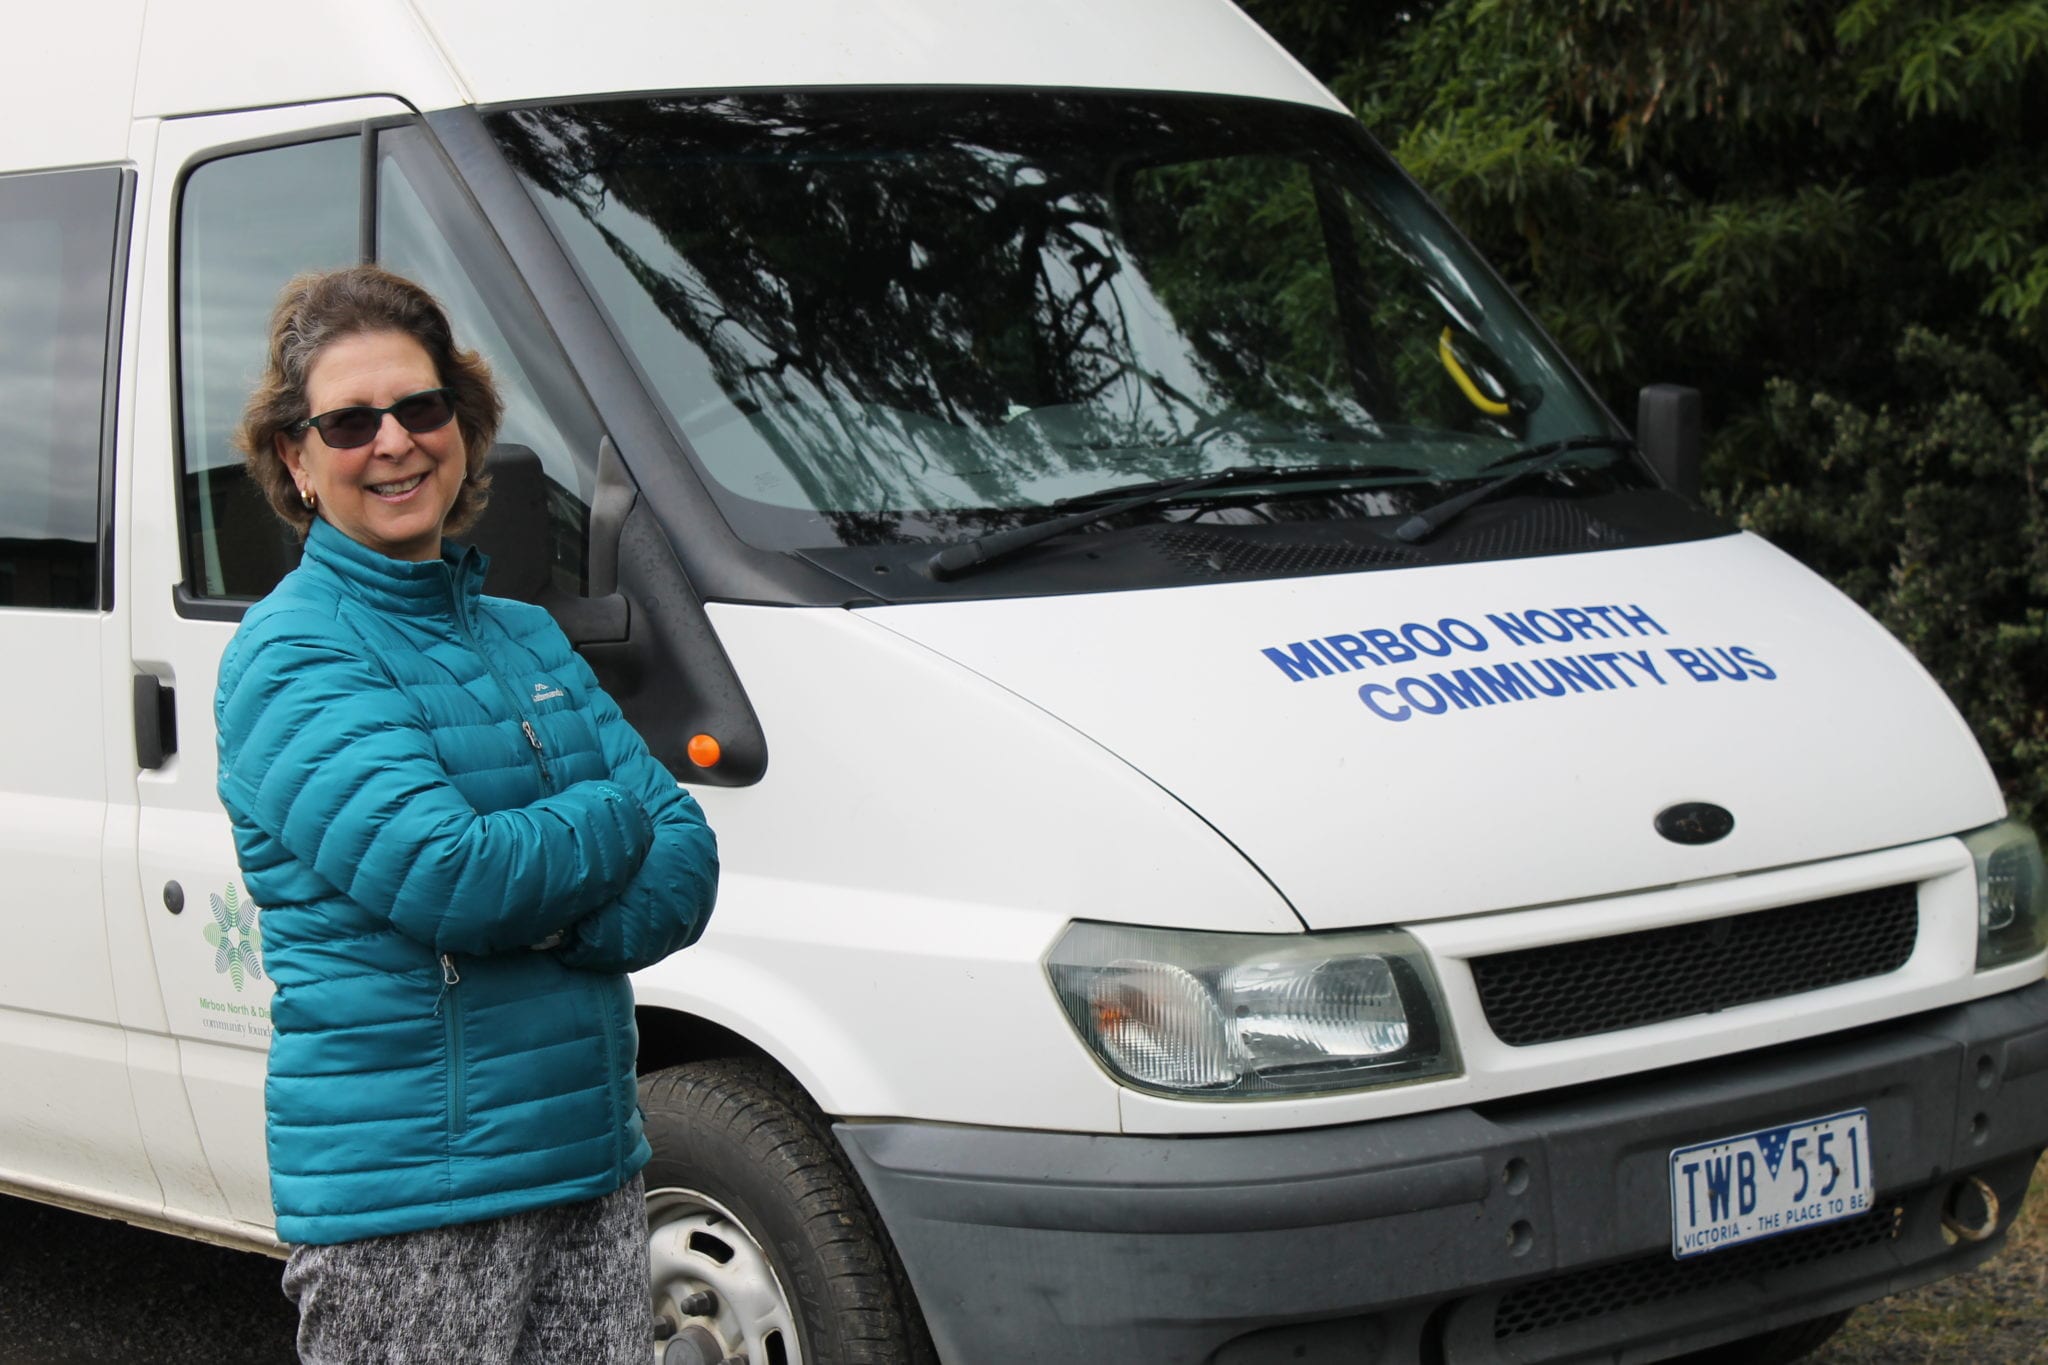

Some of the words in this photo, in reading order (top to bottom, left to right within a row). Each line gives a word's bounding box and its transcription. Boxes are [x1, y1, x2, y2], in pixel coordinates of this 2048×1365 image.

[1261, 618, 1489, 682] MIRBOO
[1485, 604, 1669, 646] NORTH
[1357, 650, 1669, 722] COMMUNITY
[1665, 645, 1778, 682] BUS
[199, 997, 225, 1012] Mirboo
[227, 1002, 249, 1016] North
[250, 1006, 256, 1017] &
[202, 1018, 245, 1038] community
[248, 1022, 272, 1038] found
[1682, 1151, 1757, 1228] TWB
[1791, 1126, 1860, 1203] 551
[1683, 1222, 1741, 1249] VICTORIA
[1758, 1213, 1780, 1231] THE
[1785, 1203, 1823, 1225] PLACE
[1828, 1198, 1844, 1214] TO
[1850, 1193, 1864, 1210] BE
